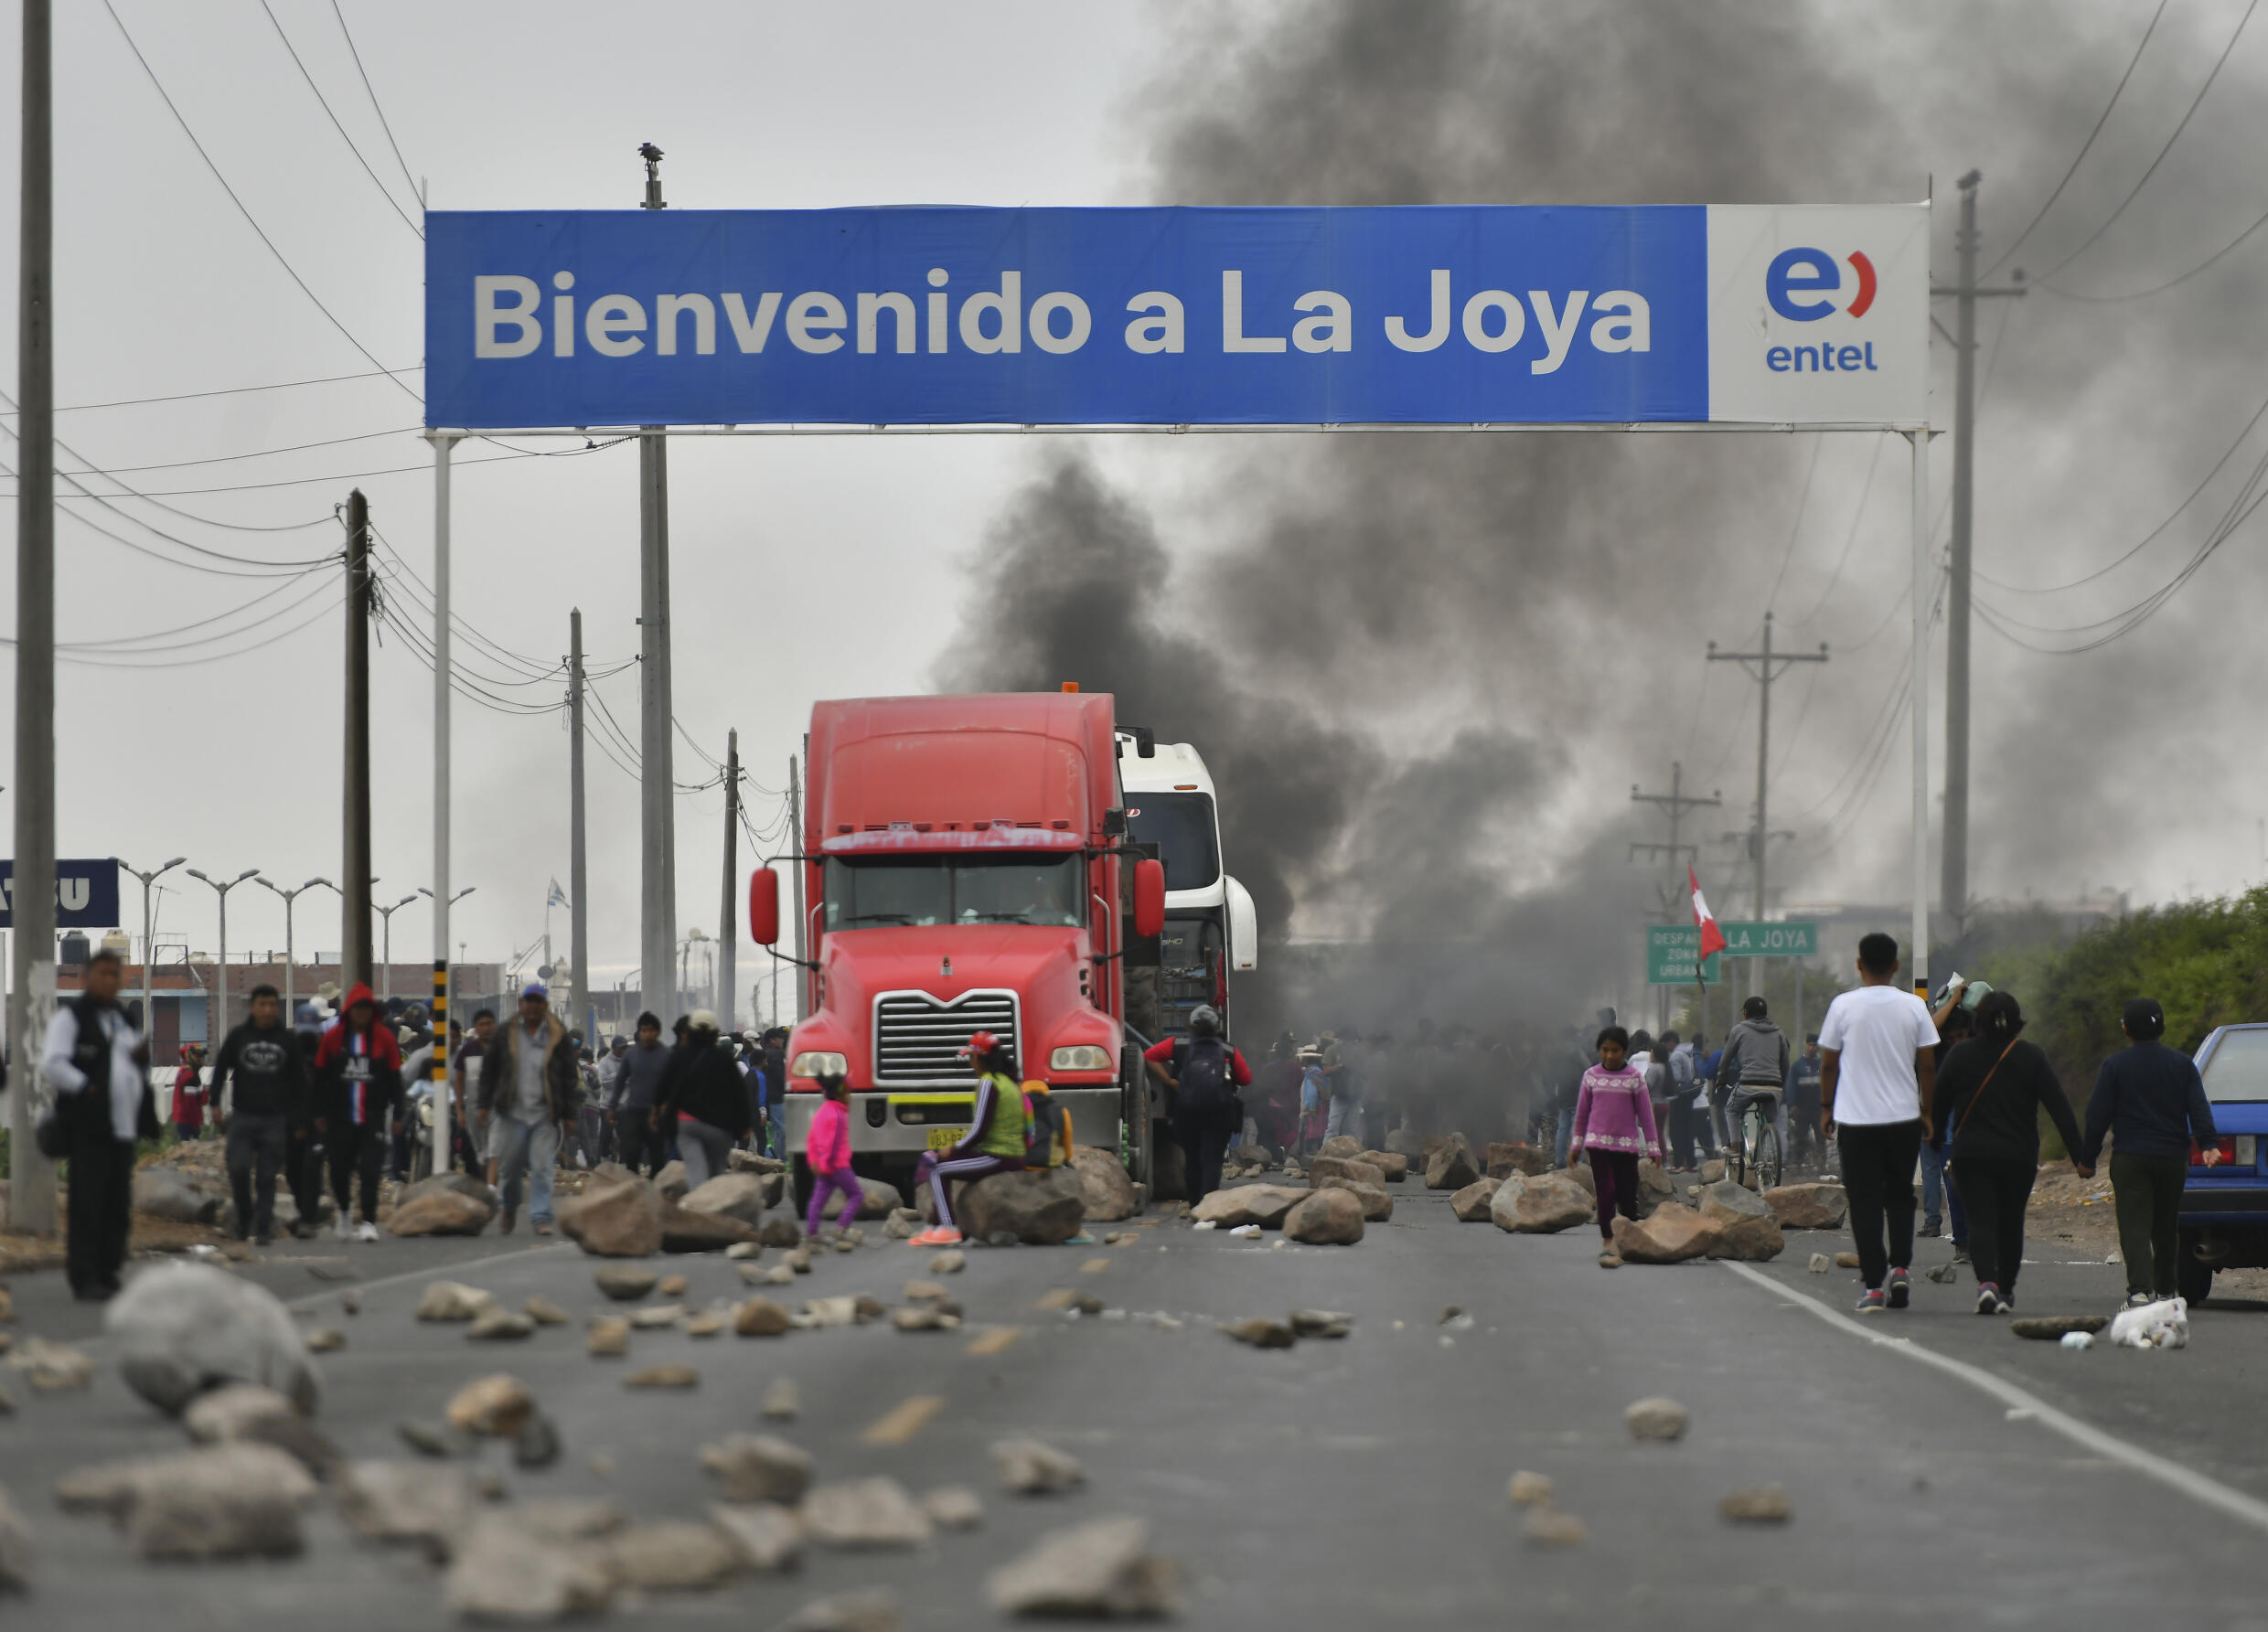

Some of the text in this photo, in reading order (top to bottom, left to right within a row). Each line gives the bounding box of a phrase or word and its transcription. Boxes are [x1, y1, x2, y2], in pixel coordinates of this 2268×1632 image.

[476, 269, 1651, 375] Bienvenido a La Joya
[1766, 341, 1878, 372] entel
[1728, 930, 1808, 948] LA JOYA
